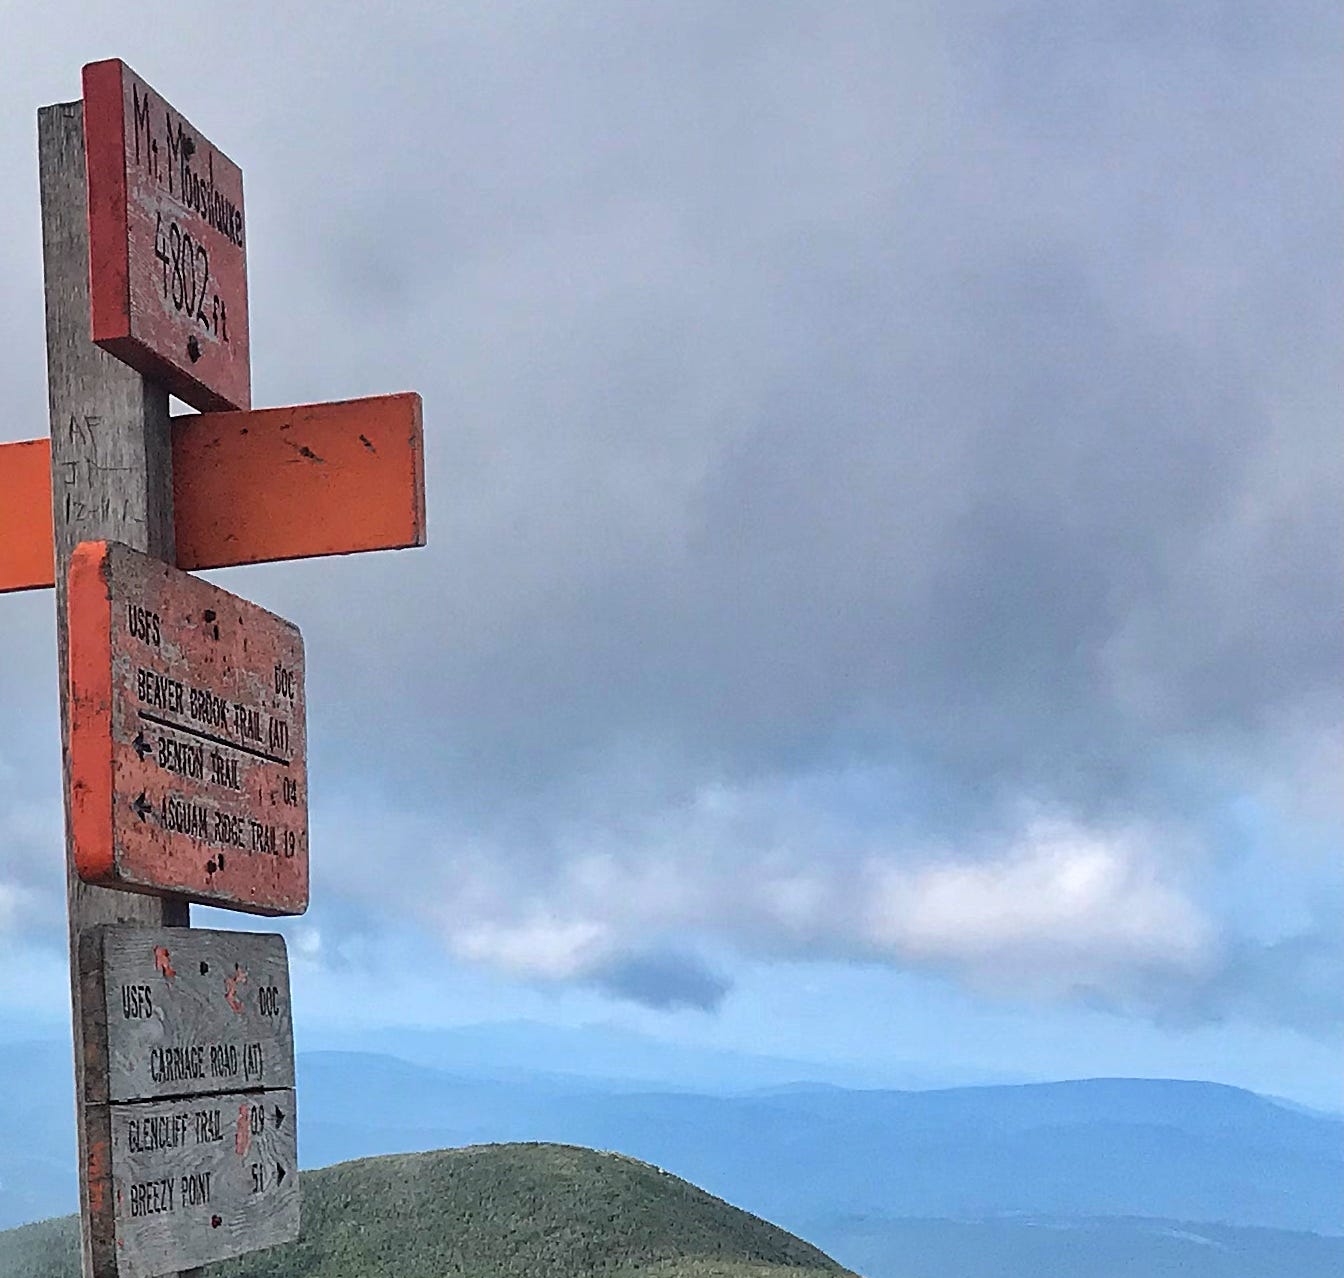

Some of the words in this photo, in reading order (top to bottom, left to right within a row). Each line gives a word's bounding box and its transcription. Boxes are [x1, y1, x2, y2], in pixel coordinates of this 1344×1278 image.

[154, 211, 210, 331] 4802
[213, 294, 229, 343] ft
[128, 604, 161, 647] USFS
[274, 663, 295, 699] DOC
[137, 667, 184, 715] BEAVER
[189, 687, 230, 729] BROOK
[233, 704, 263, 743] TRAIL
[268, 715, 289, 754] (AT)
[158, 736, 204, 781] BENTON
[210, 751, 240, 791] TRAIL
[160, 795, 209, 841] ASQUAM
[214, 810, 245, 849] RIDGE
[250, 820, 280, 856] TRAIL
[122, 985, 153, 1019] USFS
[258, 986, 280, 1016] DOC
[150, 1045, 205, 1083] CARRIAGE
[210, 1044, 238, 1078] ROAD
[243, 1042, 263, 1082] (AT)
[128, 1113, 188, 1153] GLENCLIFF
[195, 1109, 224, 1145] TRAIL
[130, 1177, 175, 1218] BREEZY
[181, 1171, 211, 1208] POINT
